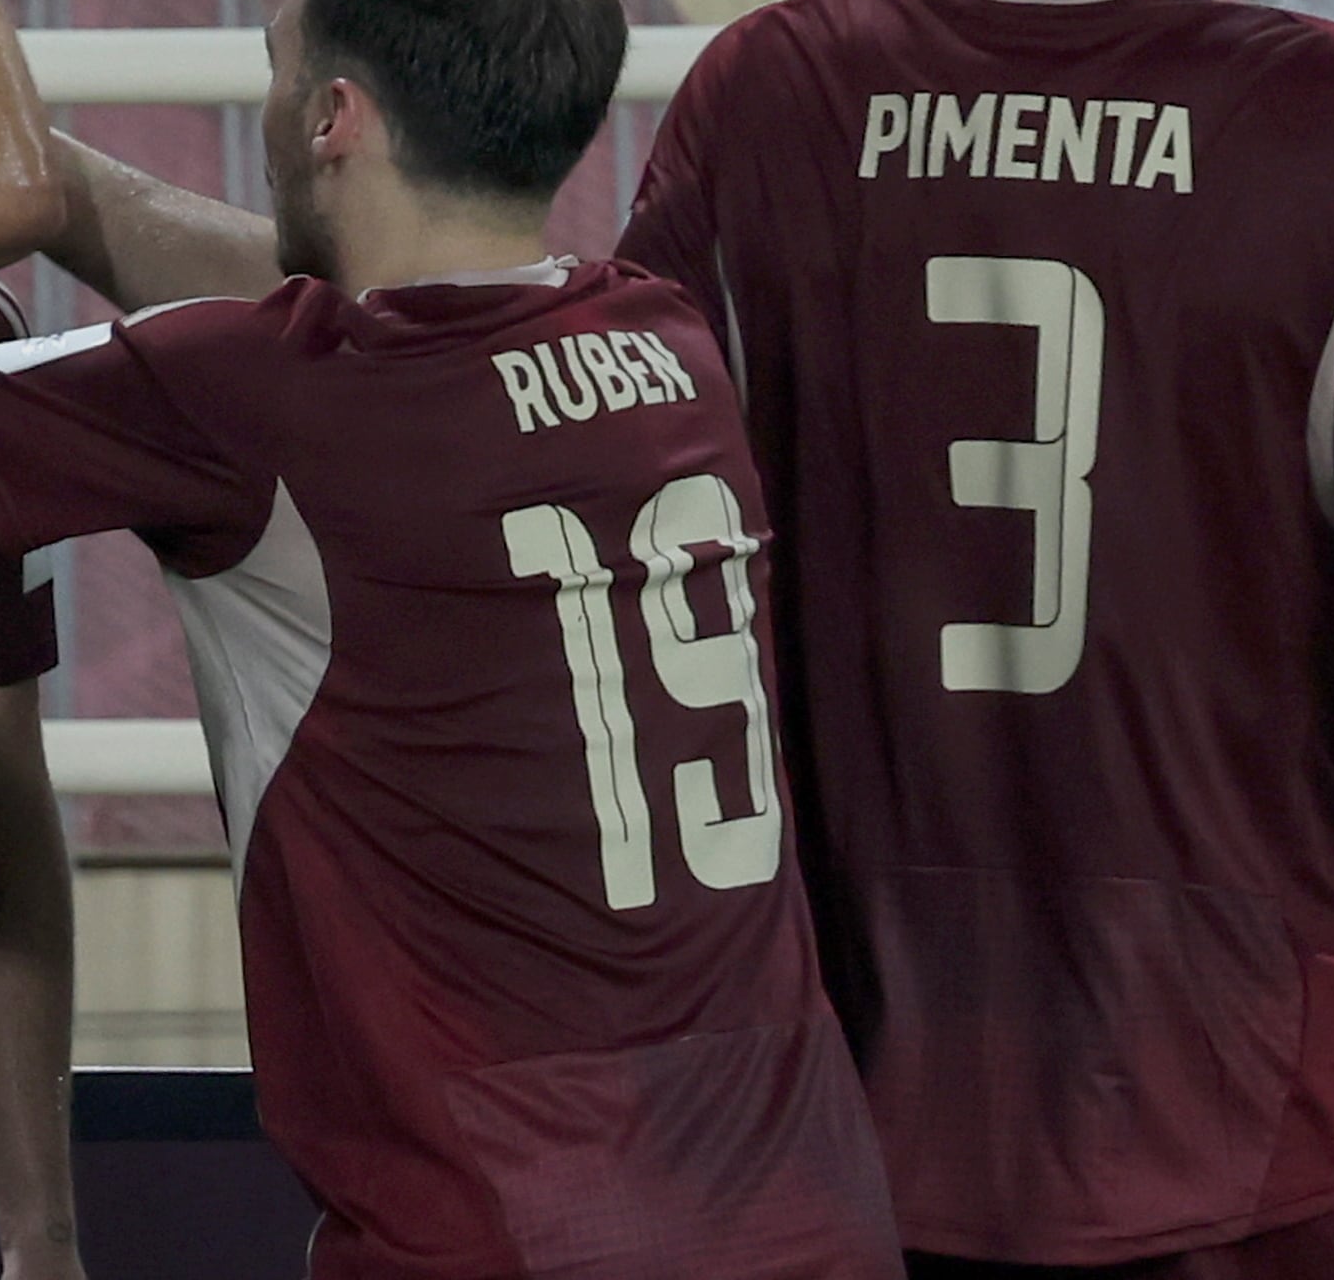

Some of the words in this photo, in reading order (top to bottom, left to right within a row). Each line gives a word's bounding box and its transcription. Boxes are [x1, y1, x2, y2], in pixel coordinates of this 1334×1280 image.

[858, 92, 1194, 194] PIMENTA
[491, 331, 697, 433] RUBEN
[926, 256, 1105, 694] 3
[501, 474, 782, 910] 19
